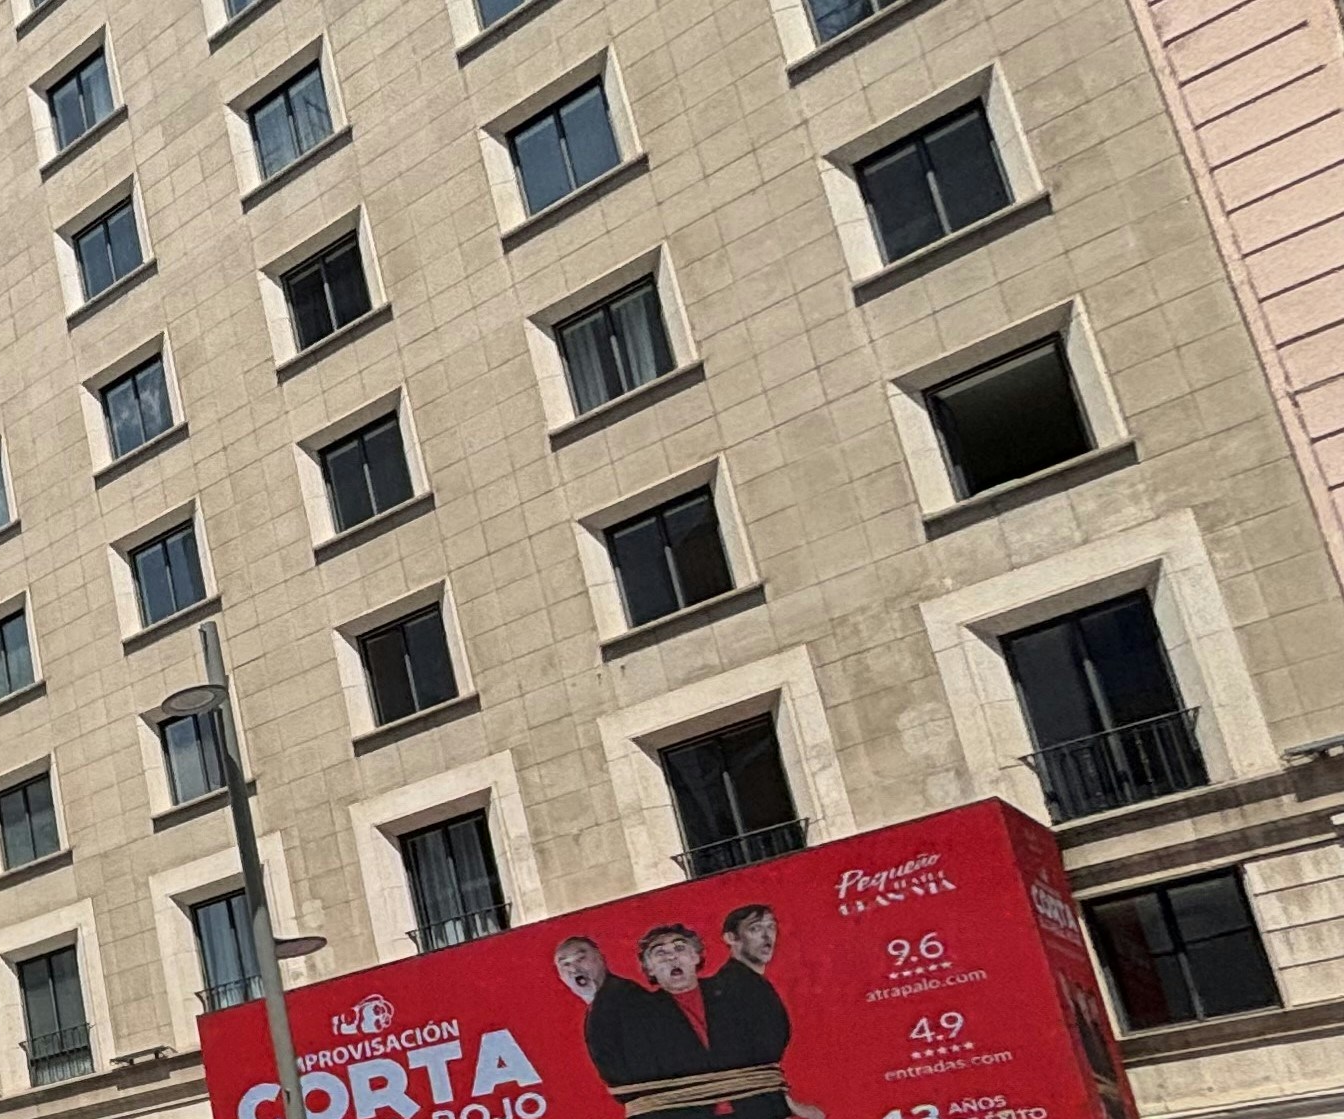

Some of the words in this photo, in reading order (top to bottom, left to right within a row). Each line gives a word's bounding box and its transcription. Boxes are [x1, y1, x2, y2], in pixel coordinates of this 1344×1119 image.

[835, 852, 941, 899] Pequeño
[887, 931, 944, 965] 9.6
[865, 968, 987, 1003] atrapalo.com
[909, 1011, 964, 1043] 4.9
[884, 1050, 1013, 1082] entradas.com
[948, 1094, 1007, 1114] AÑOS
